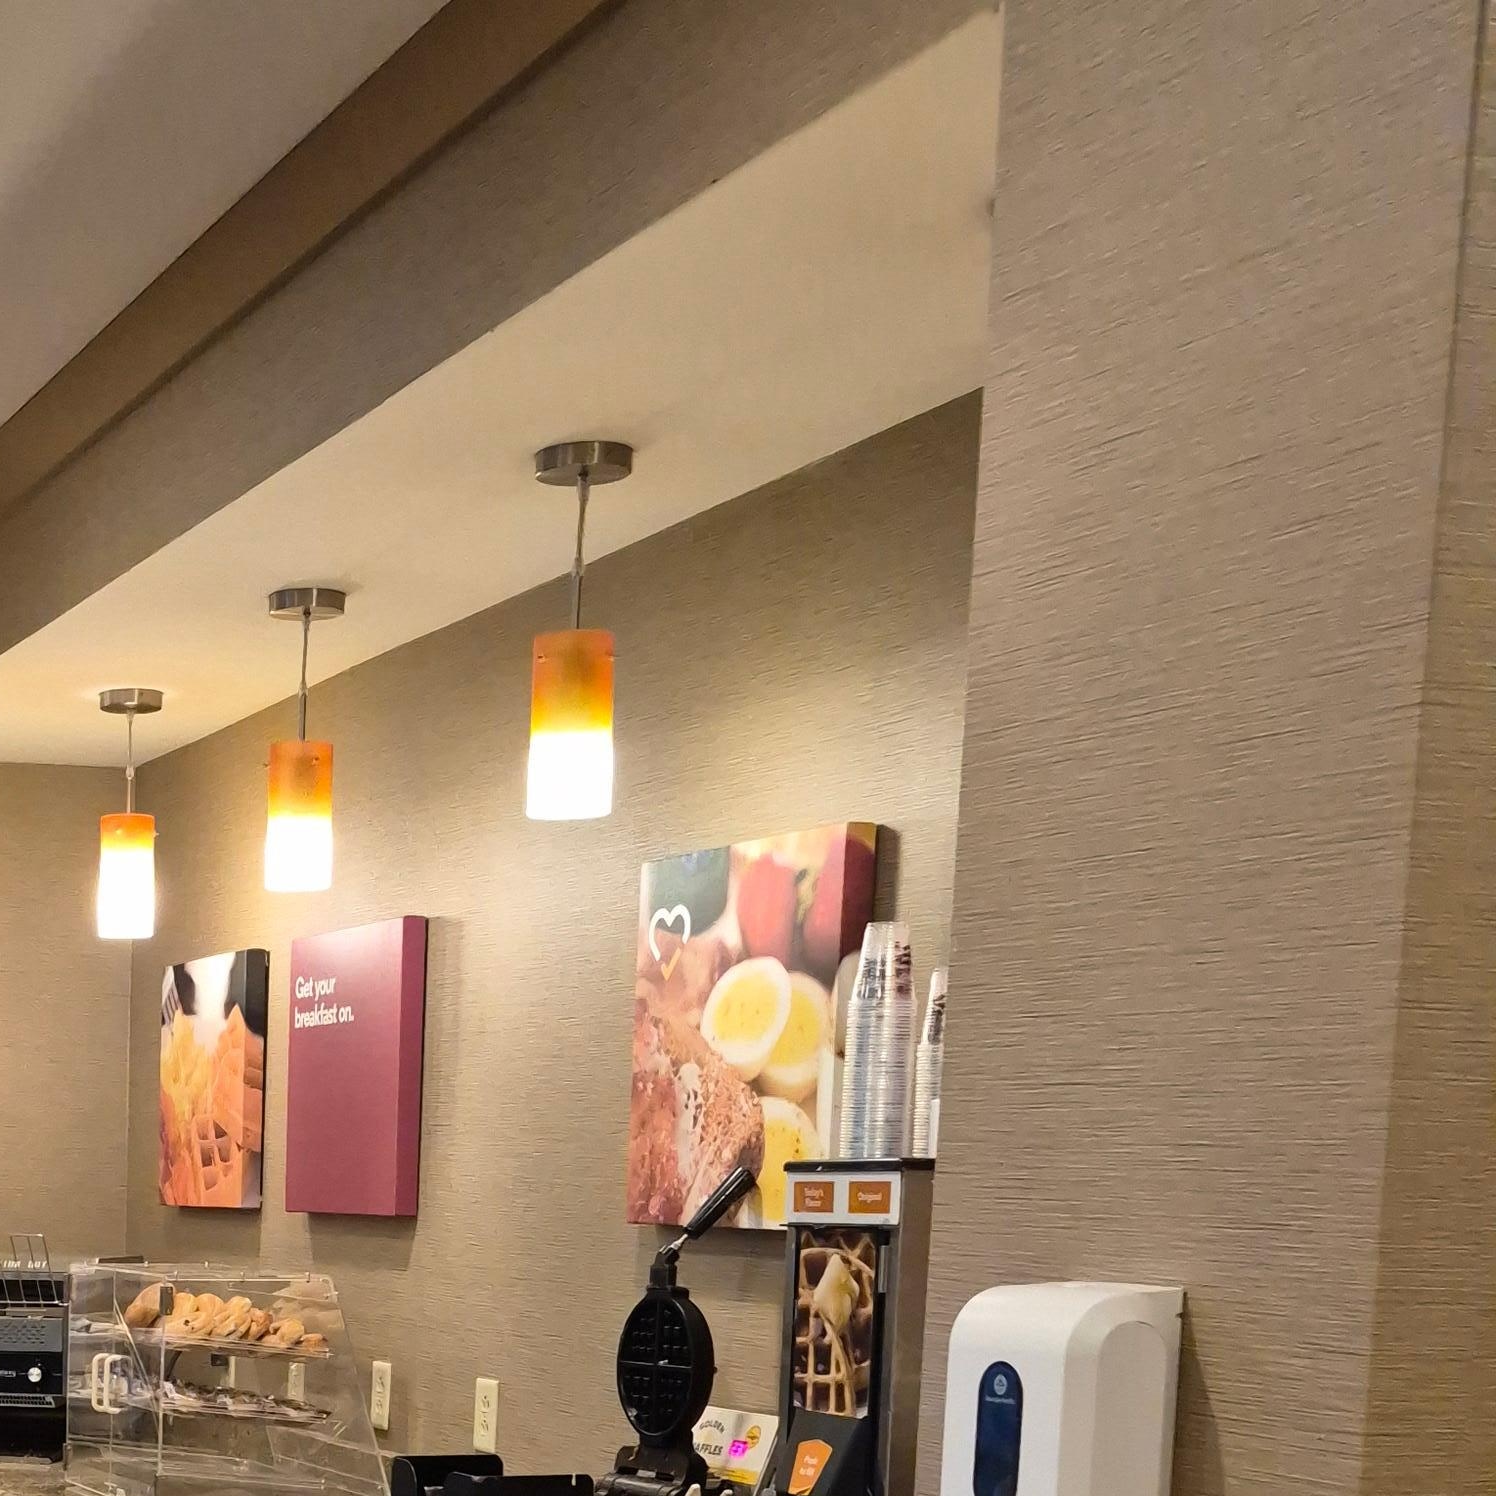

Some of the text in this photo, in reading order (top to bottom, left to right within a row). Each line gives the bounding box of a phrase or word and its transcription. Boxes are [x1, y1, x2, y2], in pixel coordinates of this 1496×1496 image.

[295, 976, 336, 1001] Get your
[294, 1002, 355, 1029] breakfast on.
